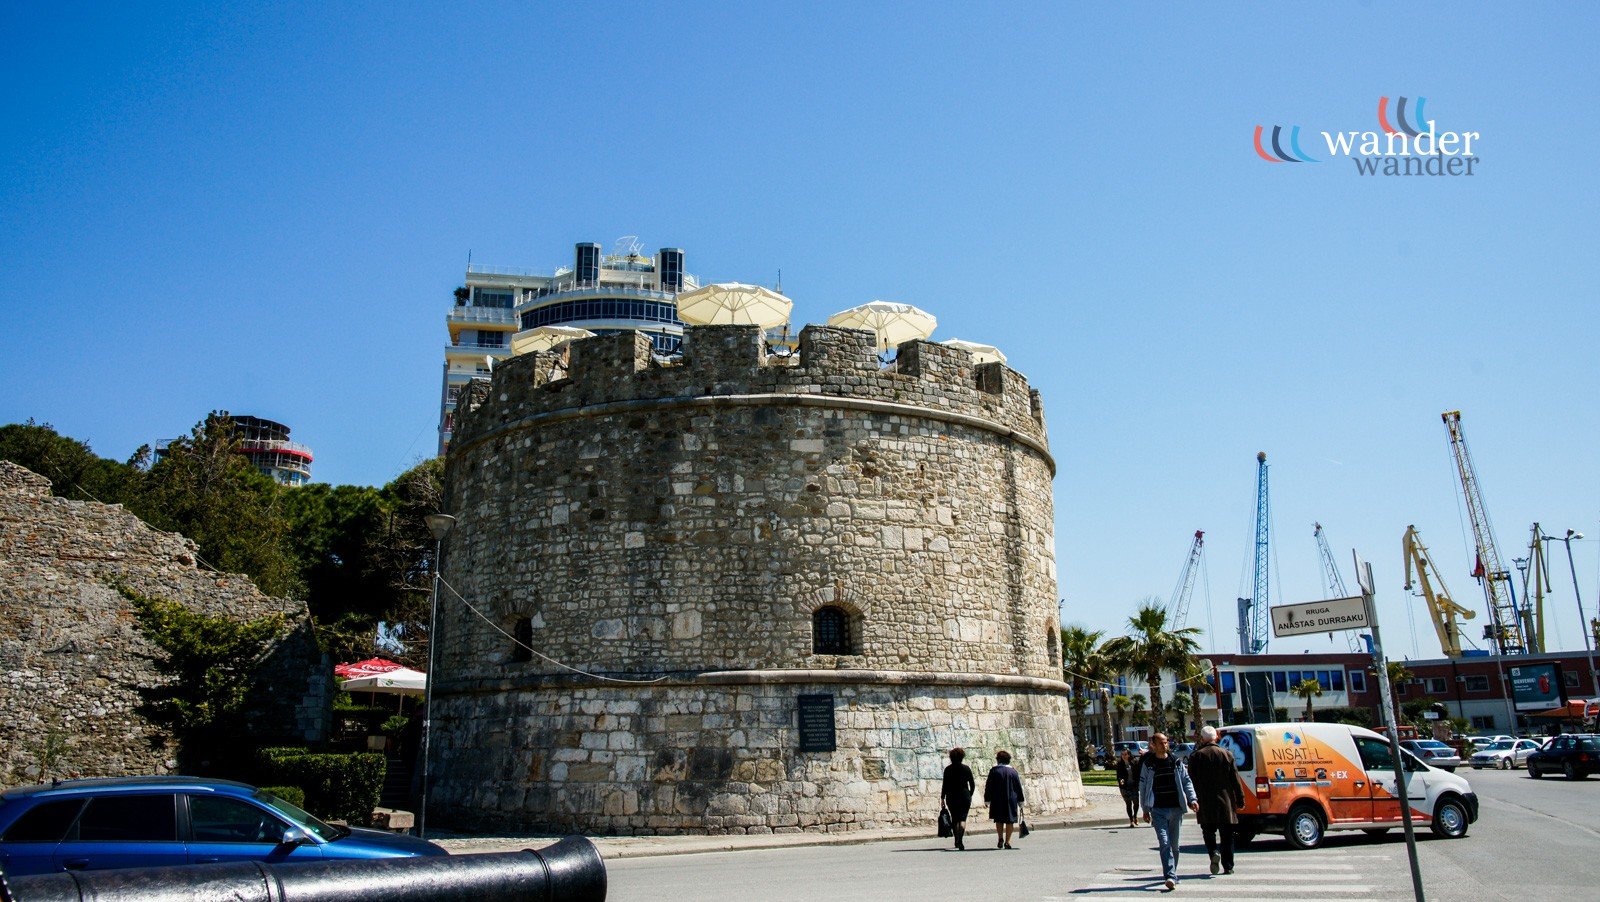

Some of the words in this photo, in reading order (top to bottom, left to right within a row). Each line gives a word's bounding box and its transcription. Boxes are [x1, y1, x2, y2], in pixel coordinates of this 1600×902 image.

[1305, 607, 1330, 615] RRUGA
[1278, 620, 1315, 630] ANASTAS
[1317, 614, 1364, 626] DURRSAKU
[1272, 748, 1324, 760] NISATL
